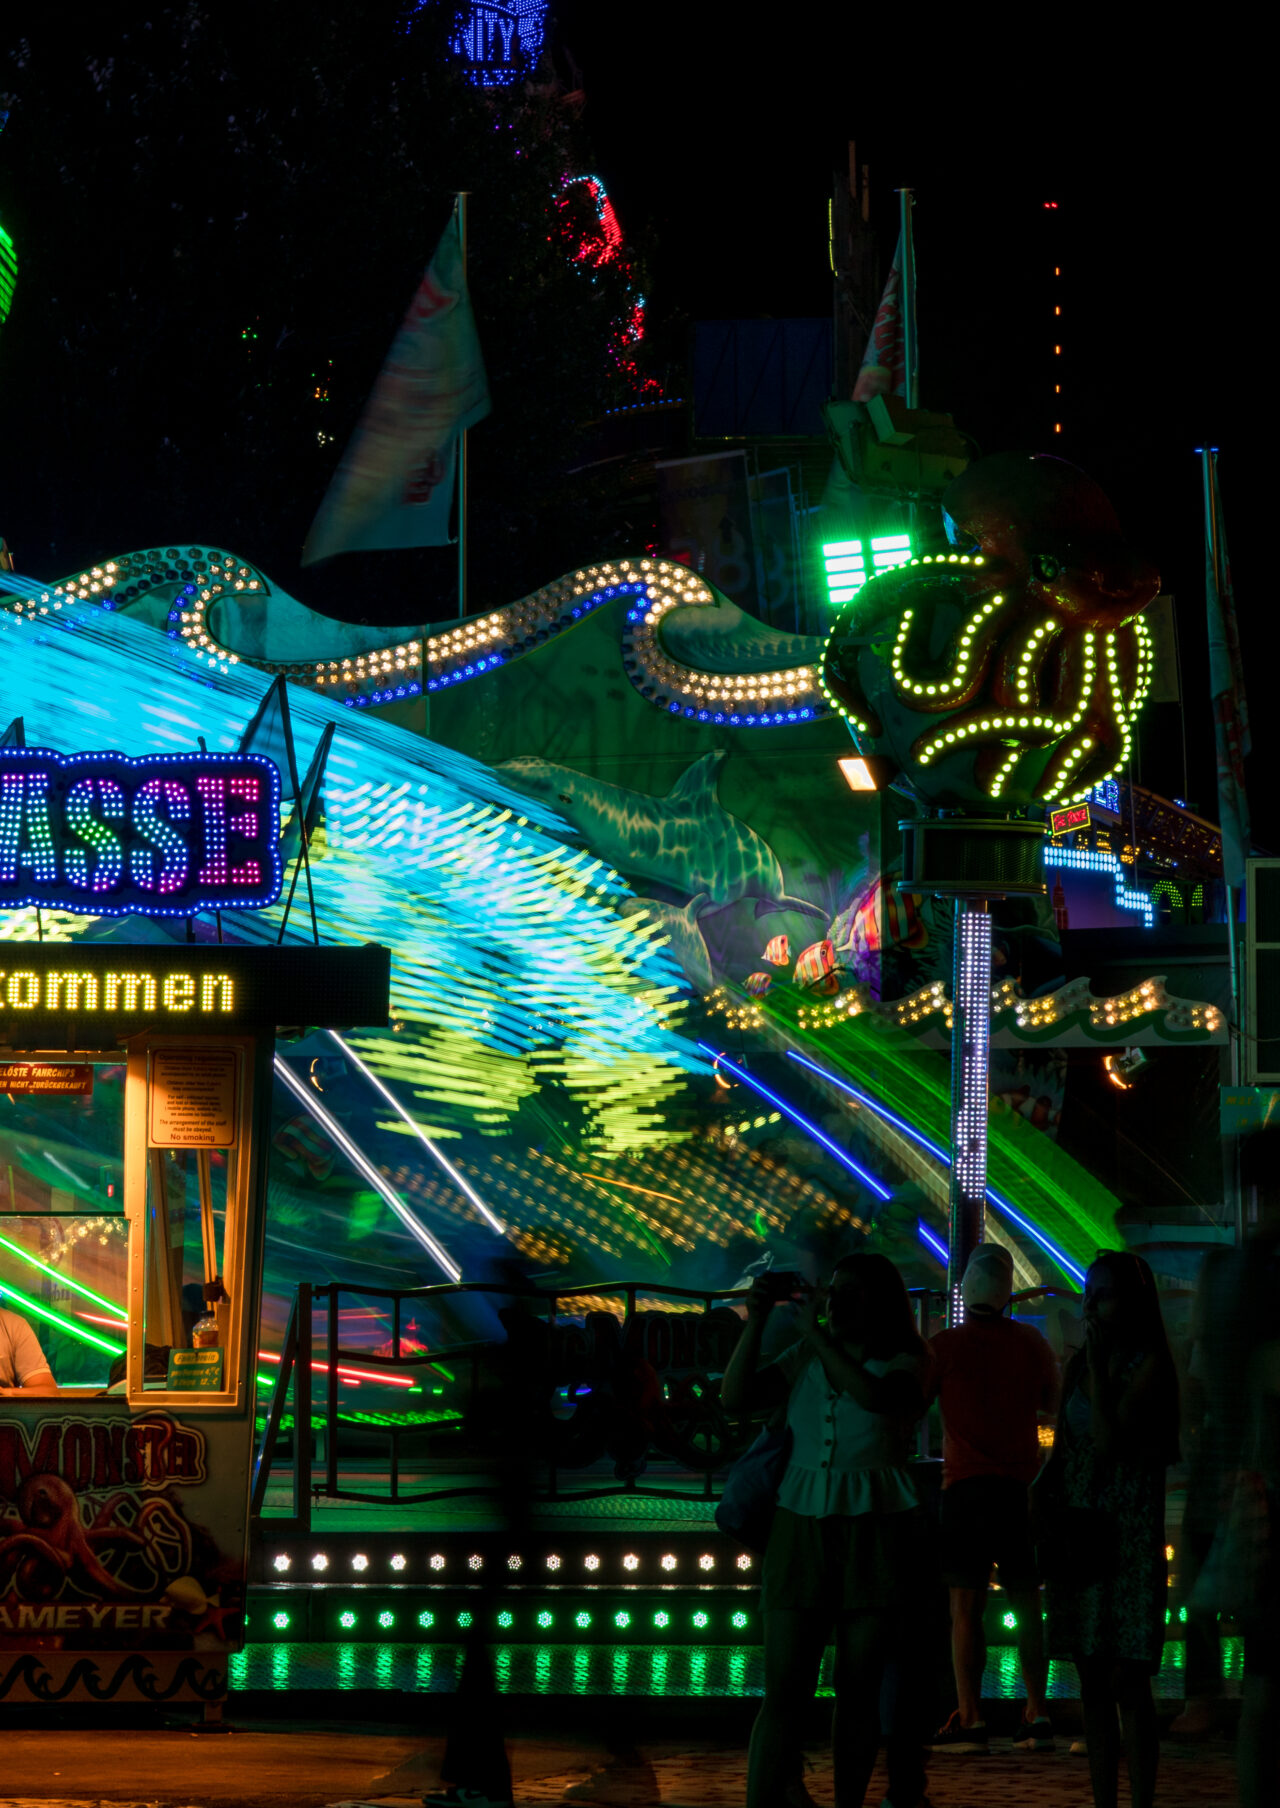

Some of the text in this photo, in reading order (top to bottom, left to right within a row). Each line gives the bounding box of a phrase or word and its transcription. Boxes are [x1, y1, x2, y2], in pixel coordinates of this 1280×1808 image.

[31, 1067, 76, 1078] FAHRCHIPS
[9, 1080, 30, 1089] NICHT
[31, 1079, 87, 1090] ZURÜCKGEKAUFT
[170, 1133, 216, 1143] No smoking
